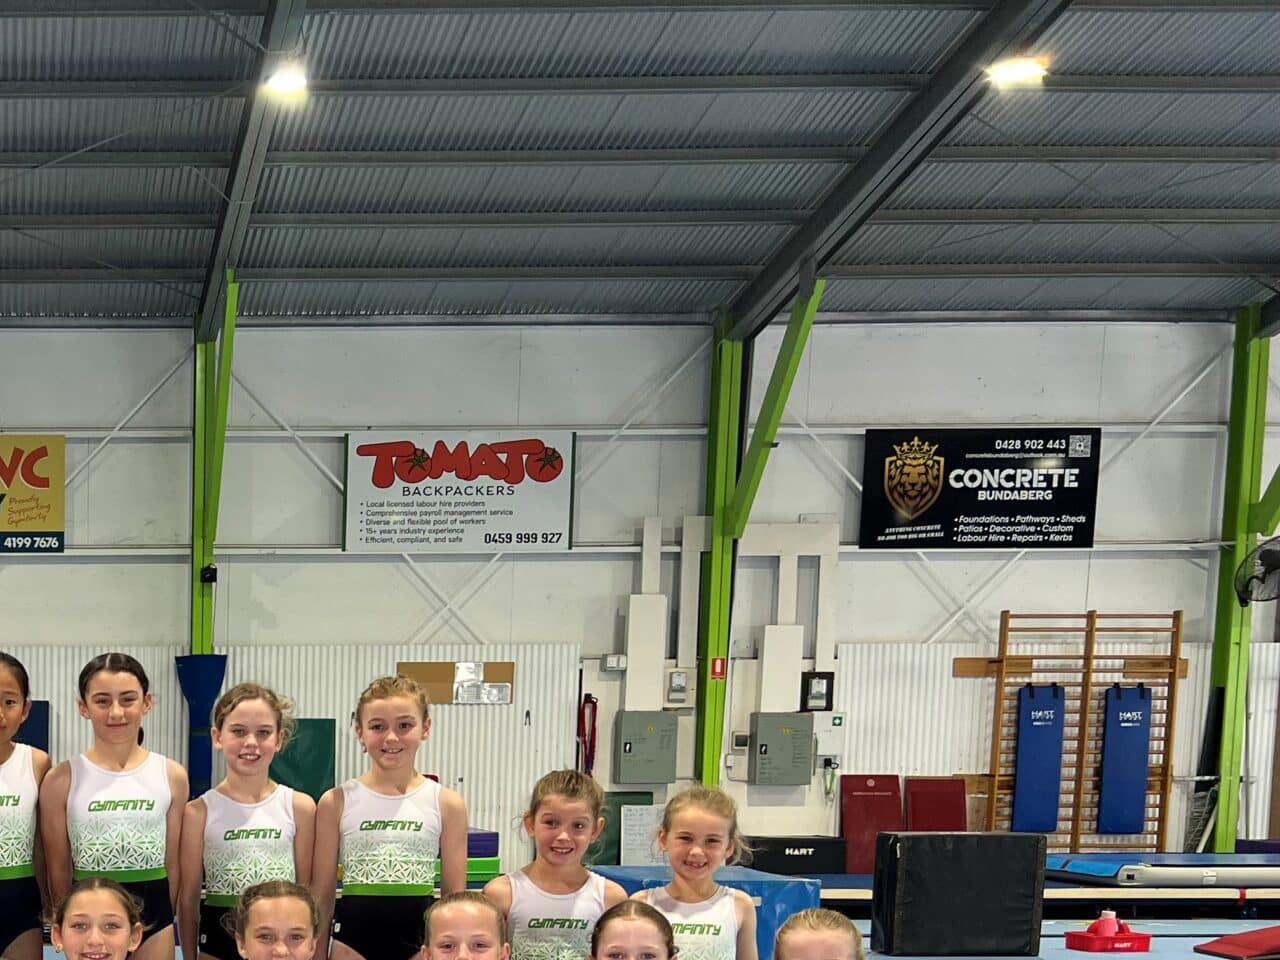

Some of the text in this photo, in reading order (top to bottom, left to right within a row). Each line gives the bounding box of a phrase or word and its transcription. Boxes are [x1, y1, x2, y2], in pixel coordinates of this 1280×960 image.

[996, 439, 1066, 449] 0428 902 443
[356, 439, 563, 488] TOMATO
[949, 469, 1079, 488] CONCRETE
[402, 485, 515, 496] BACKPACKERS
[978, 491, 1053, 501] BUNDABERG
[454, 500, 485, 508] providers
[366, 509, 417, 517] Comprehensive
[419, 509, 442, 517] payroll
[959, 515, 1086, 524] Foundations Pathways Sheds
[400, 527, 426, 535] industry
[989, 524, 1035, 533] Decorative
[1042, 524, 1074, 532] Custom
[4, 537, 31, 548] 4199
[34, 537, 58, 548] 7676
[365, 536, 395, 544] Efficient,
[484, 533, 562, 544] 0459 999 927
[958, 534, 1073, 542] Labour Hire Repairs Kerbs
[88, 798, 154, 812] GYMFINITY
[359, 819, 423, 833] GYMFINITY
[223, 827, 282, 840] GYMFINITY
[784, 847, 815, 856] HART
[528, 916, 589, 930] GYMFINITY
[670, 922, 722, 936] MFINITY
